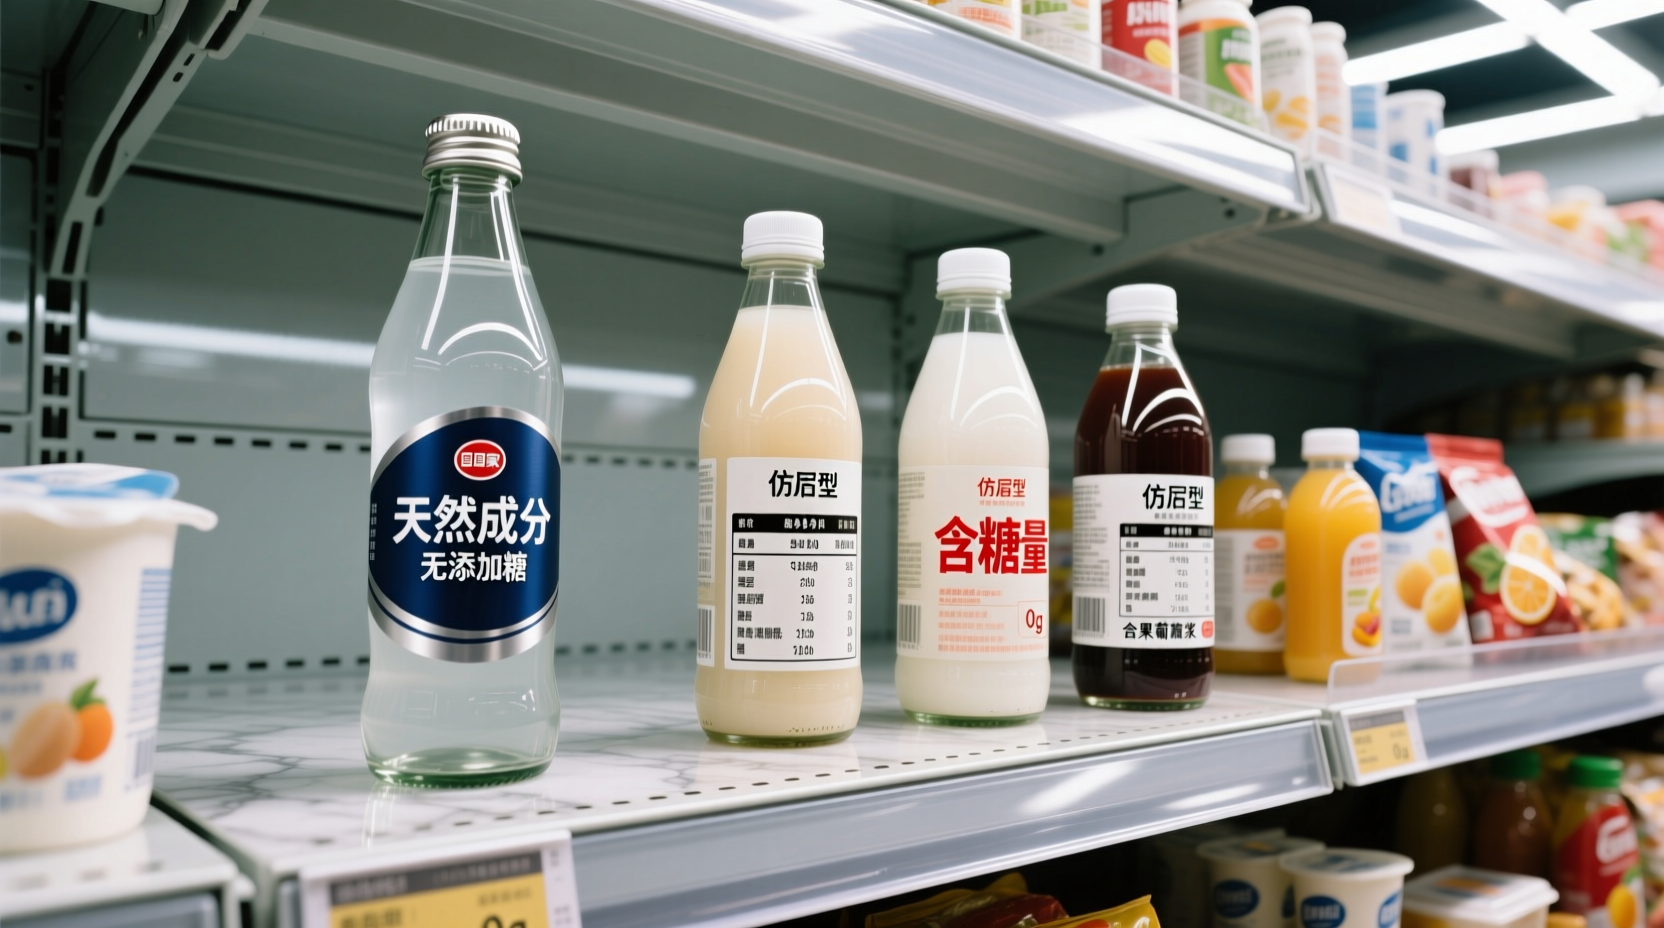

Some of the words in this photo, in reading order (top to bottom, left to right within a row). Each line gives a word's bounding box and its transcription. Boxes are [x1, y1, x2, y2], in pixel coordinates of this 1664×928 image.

[392, 494, 552, 545] 天然成分
[934, 515, 1048, 574] 含糖量
[420, 551, 528, 583] 无添加糖
[1025, 608, 1043, 634] 0g
